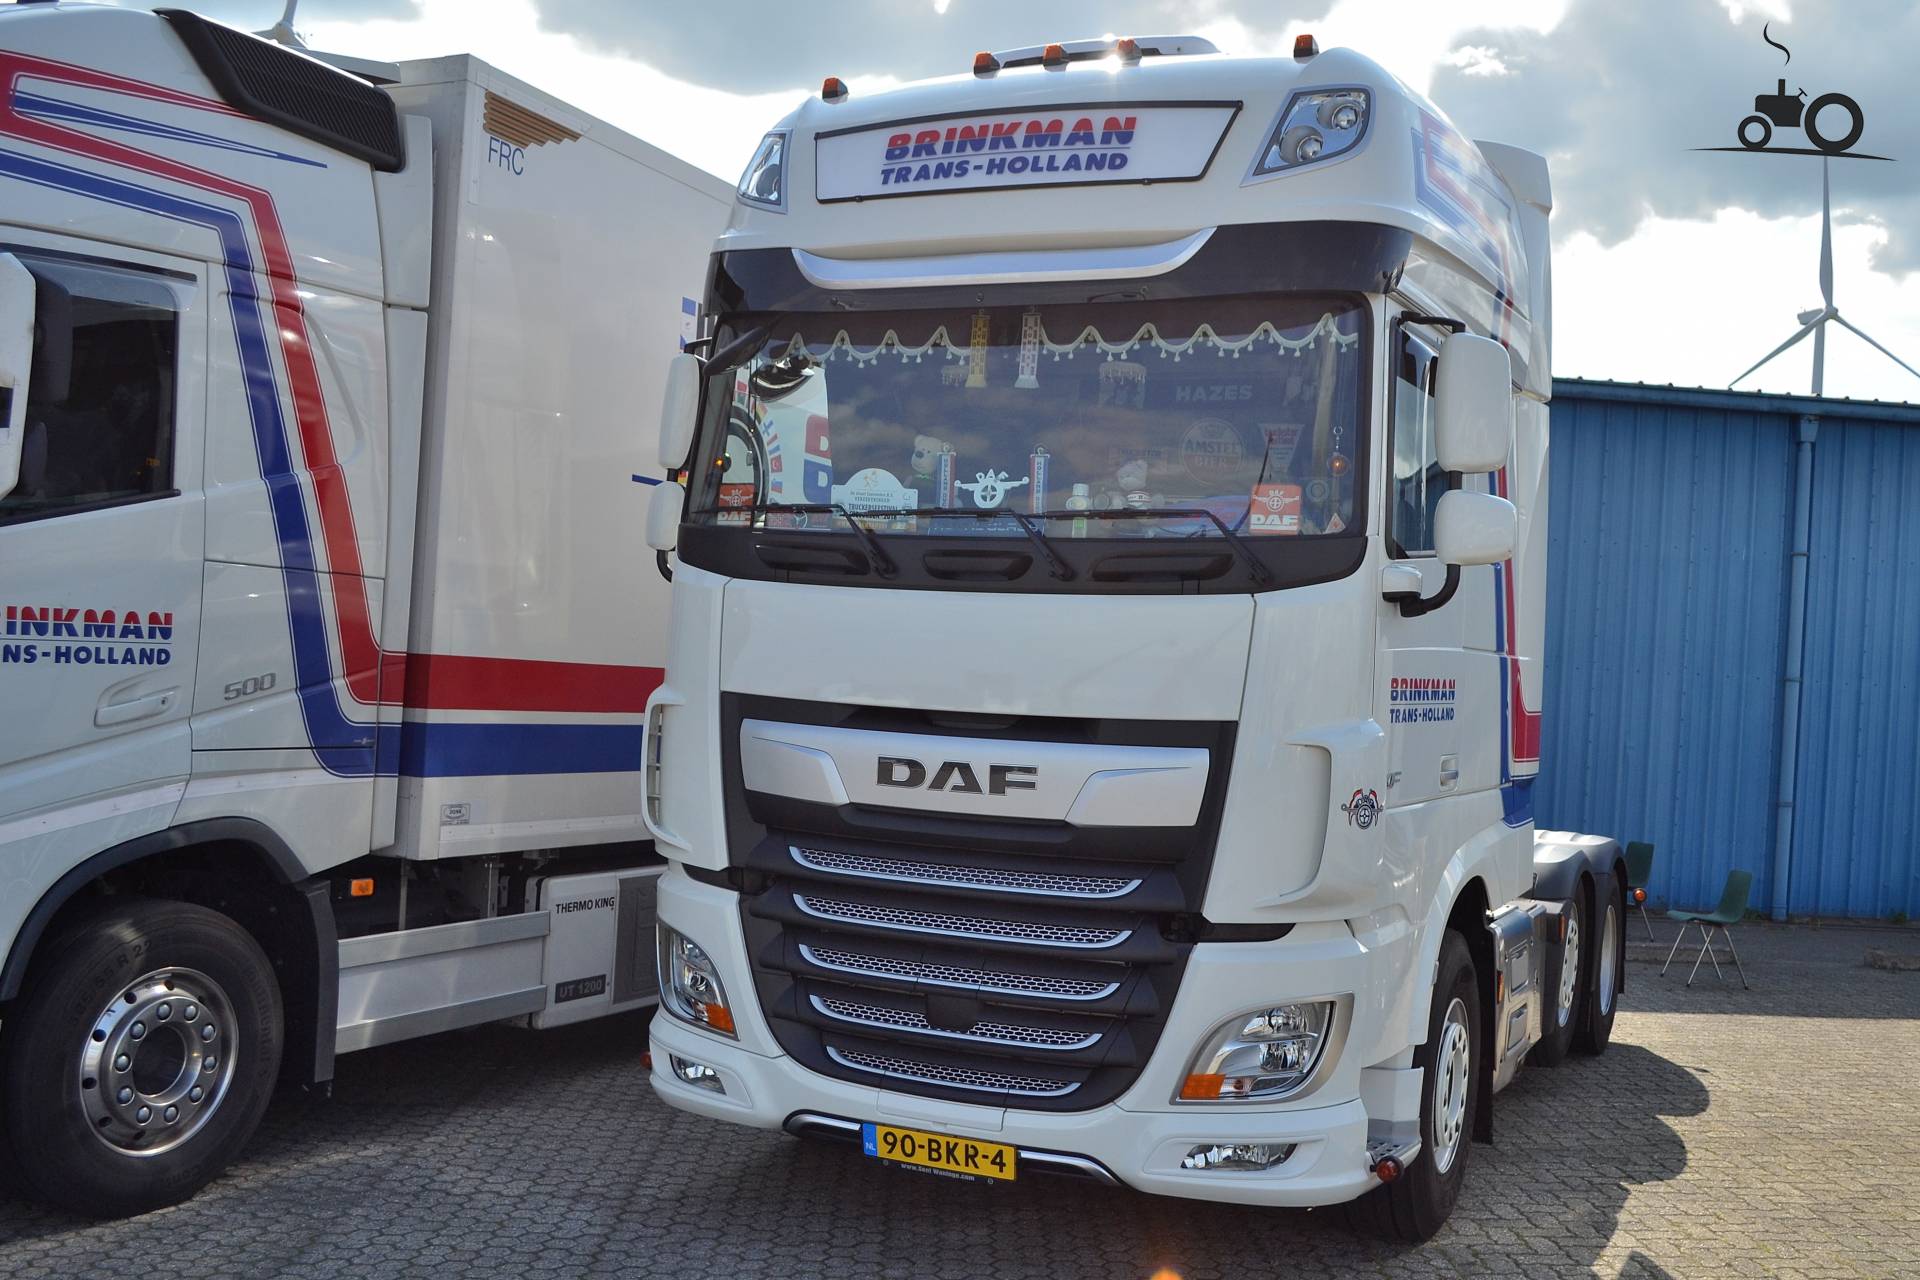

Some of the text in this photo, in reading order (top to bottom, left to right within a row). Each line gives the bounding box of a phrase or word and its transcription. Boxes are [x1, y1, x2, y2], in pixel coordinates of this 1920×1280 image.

[884, 116, 1137, 160] BRINKMAN
[488, 136, 525, 176] FRC
[880, 152, 1128, 185] TRANS-HOLLAND
[1176, 384, 1254, 401] HAZES
[1250, 514, 1299, 525] DAF
[0, 605, 173, 640] INKMAN
[224, 672, 277, 701] 500
[1390, 677, 1456, 702] BRINKMAN
[1389, 707, 1455, 723] TRANS-HOLLAND
[877, 756, 1039, 796] DAF
[555, 896, 615, 914] THERMO KING
[559, 979, 602, 998] UT 1200
[882, 1131, 1006, 1172] 90-BKR-4
